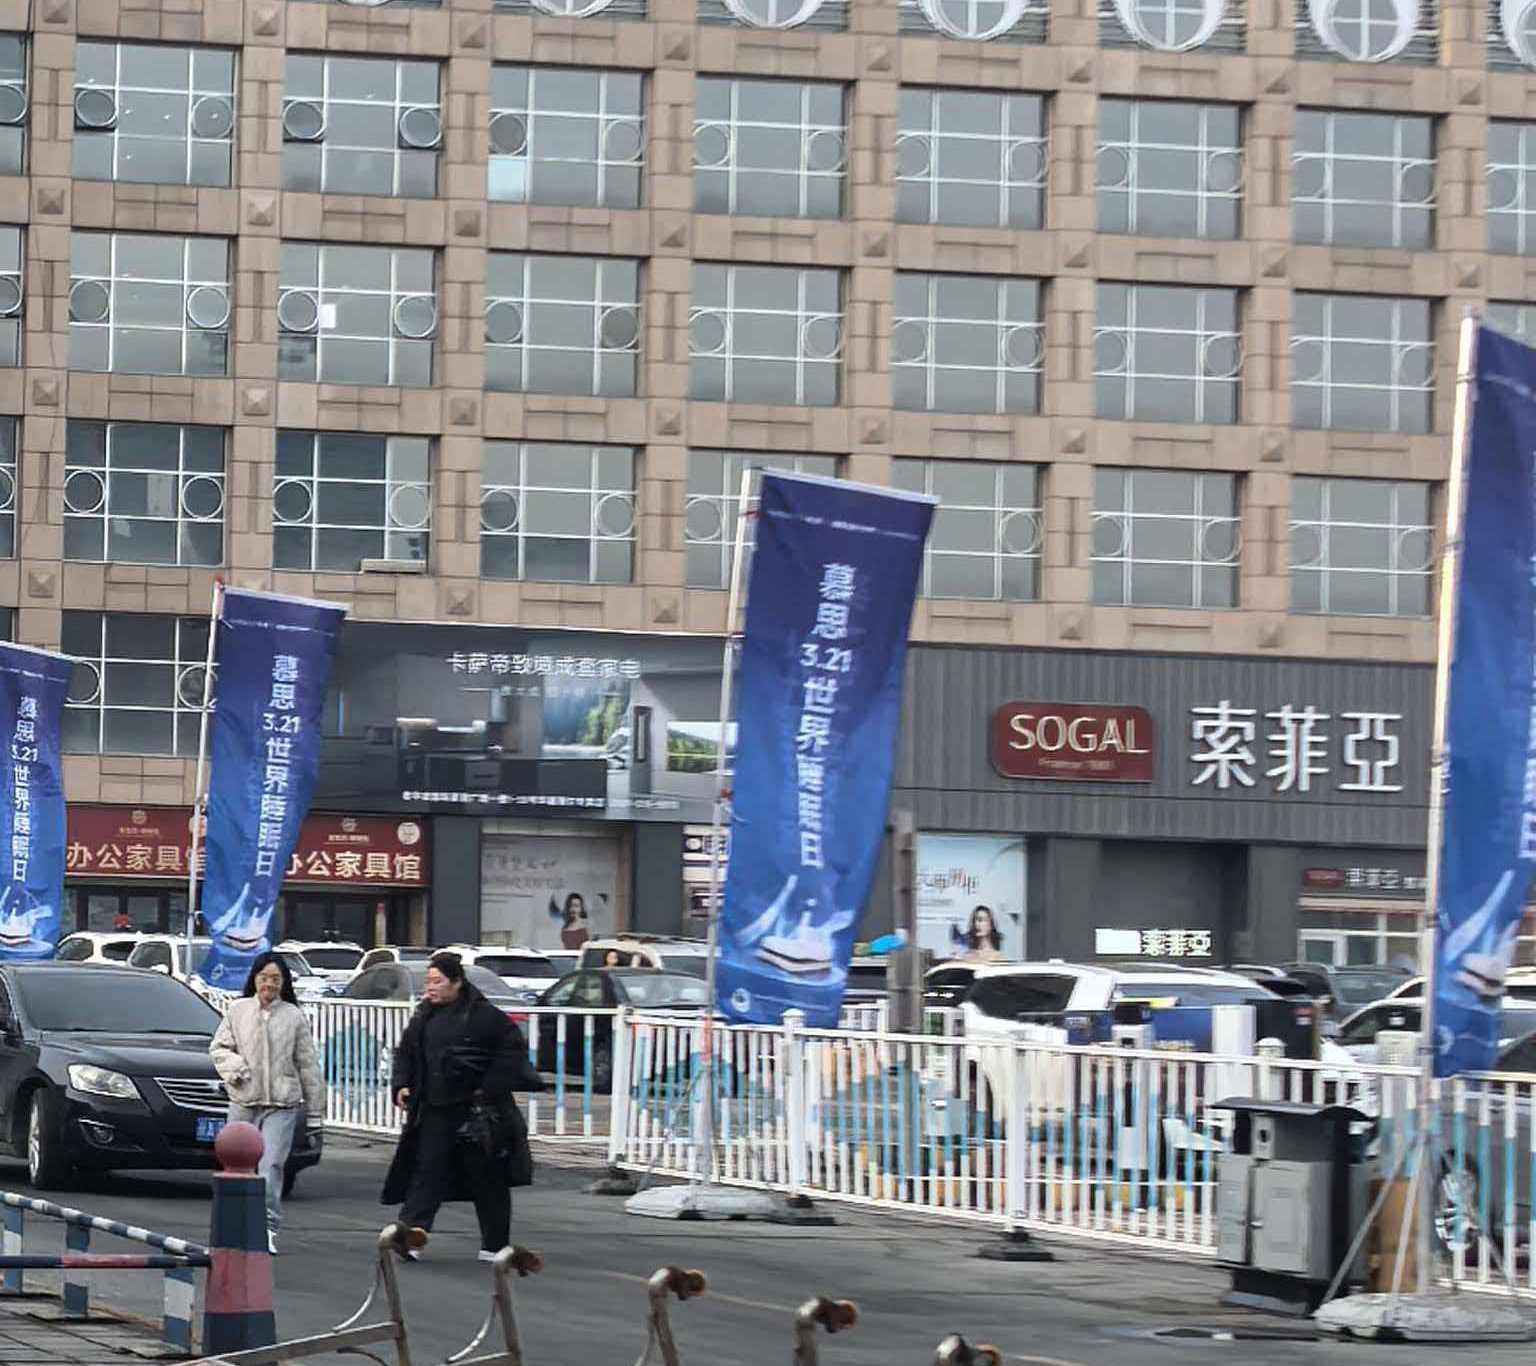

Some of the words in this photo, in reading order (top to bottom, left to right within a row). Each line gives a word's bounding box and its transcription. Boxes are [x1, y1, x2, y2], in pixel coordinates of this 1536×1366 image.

[1009, 714, 1150, 754] SOGAL
[1190, 700, 1404, 792] 索菲亞
